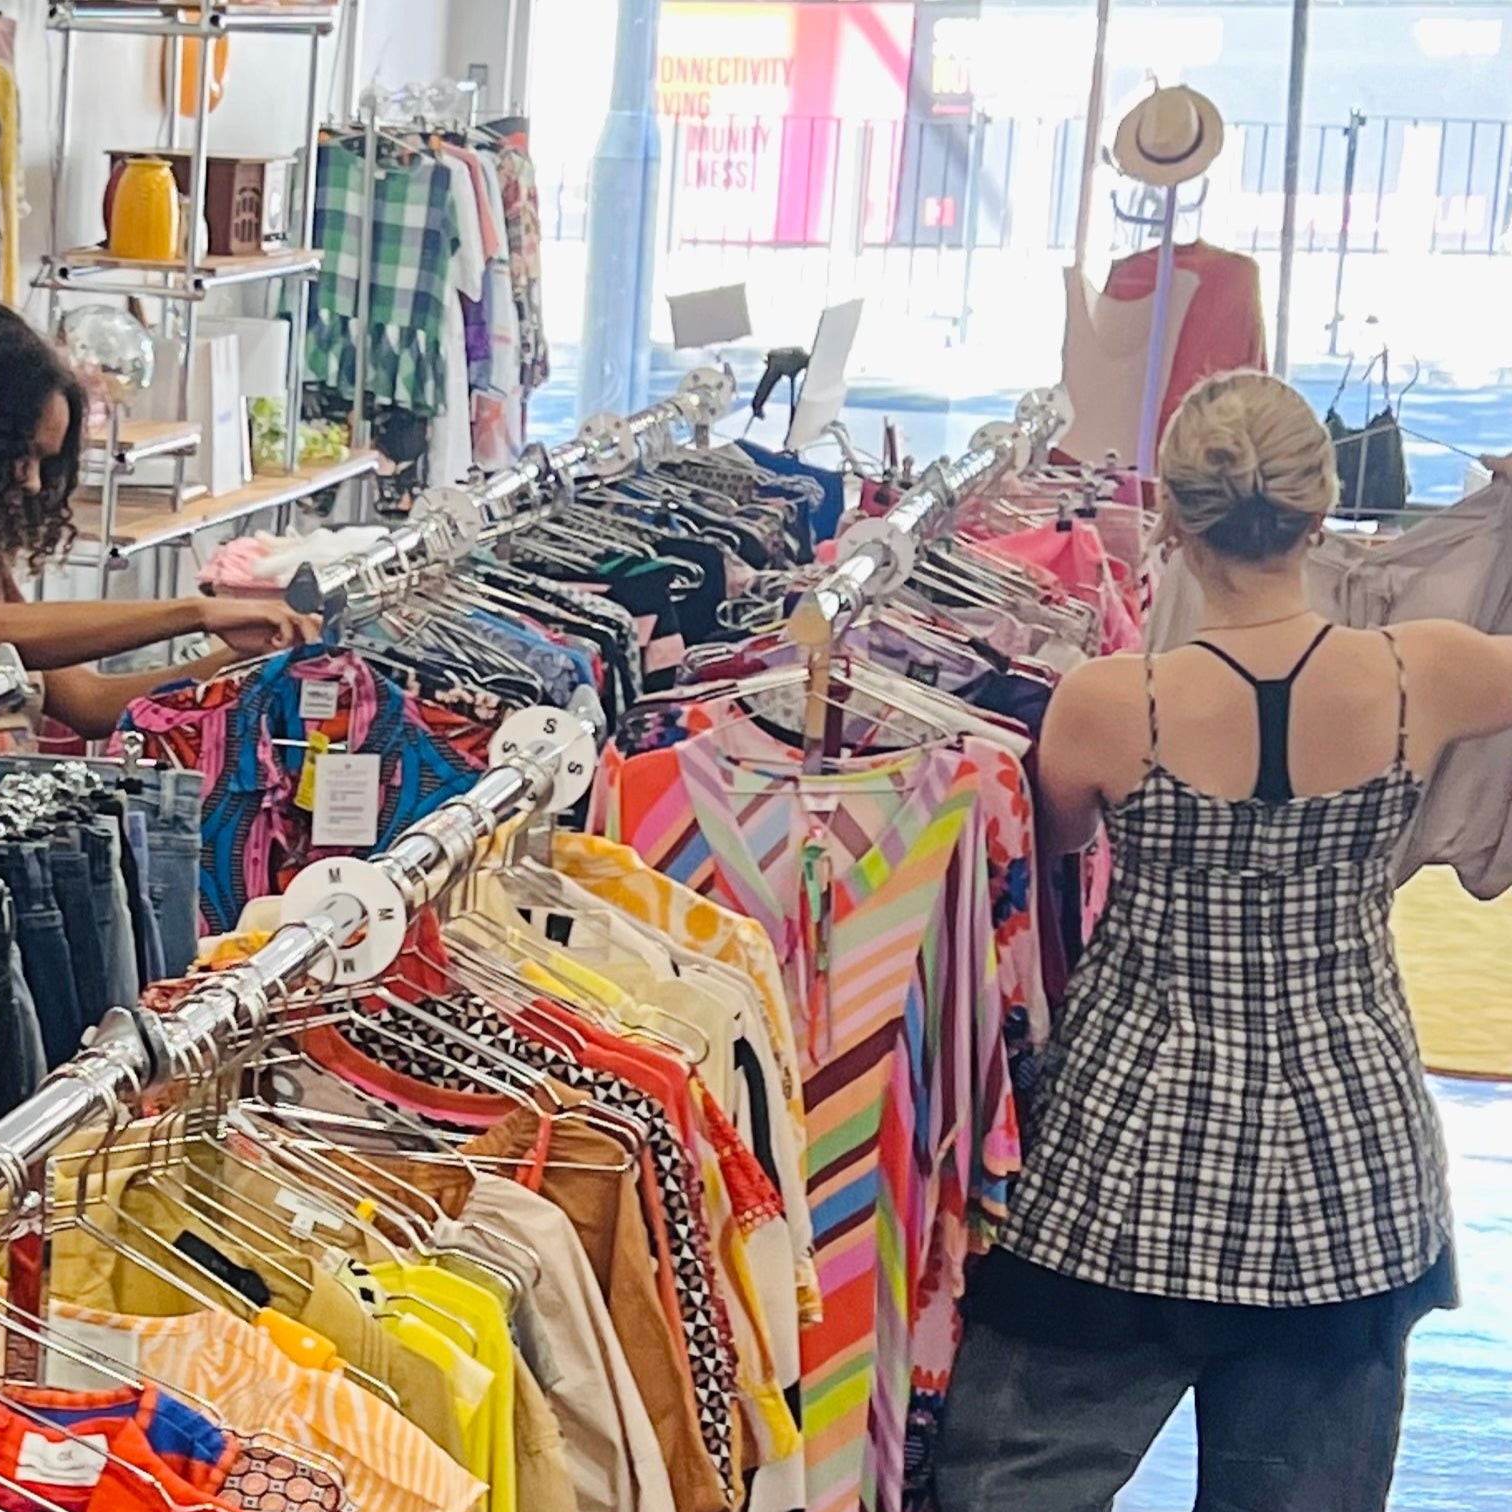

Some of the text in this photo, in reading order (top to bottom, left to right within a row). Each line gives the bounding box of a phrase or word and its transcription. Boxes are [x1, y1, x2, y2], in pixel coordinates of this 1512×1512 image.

[659, 55, 795, 87] ONNECTIVITY
[543, 717, 557, 735] S
[502, 741, 517, 753] S
[568, 761, 583, 775] S
